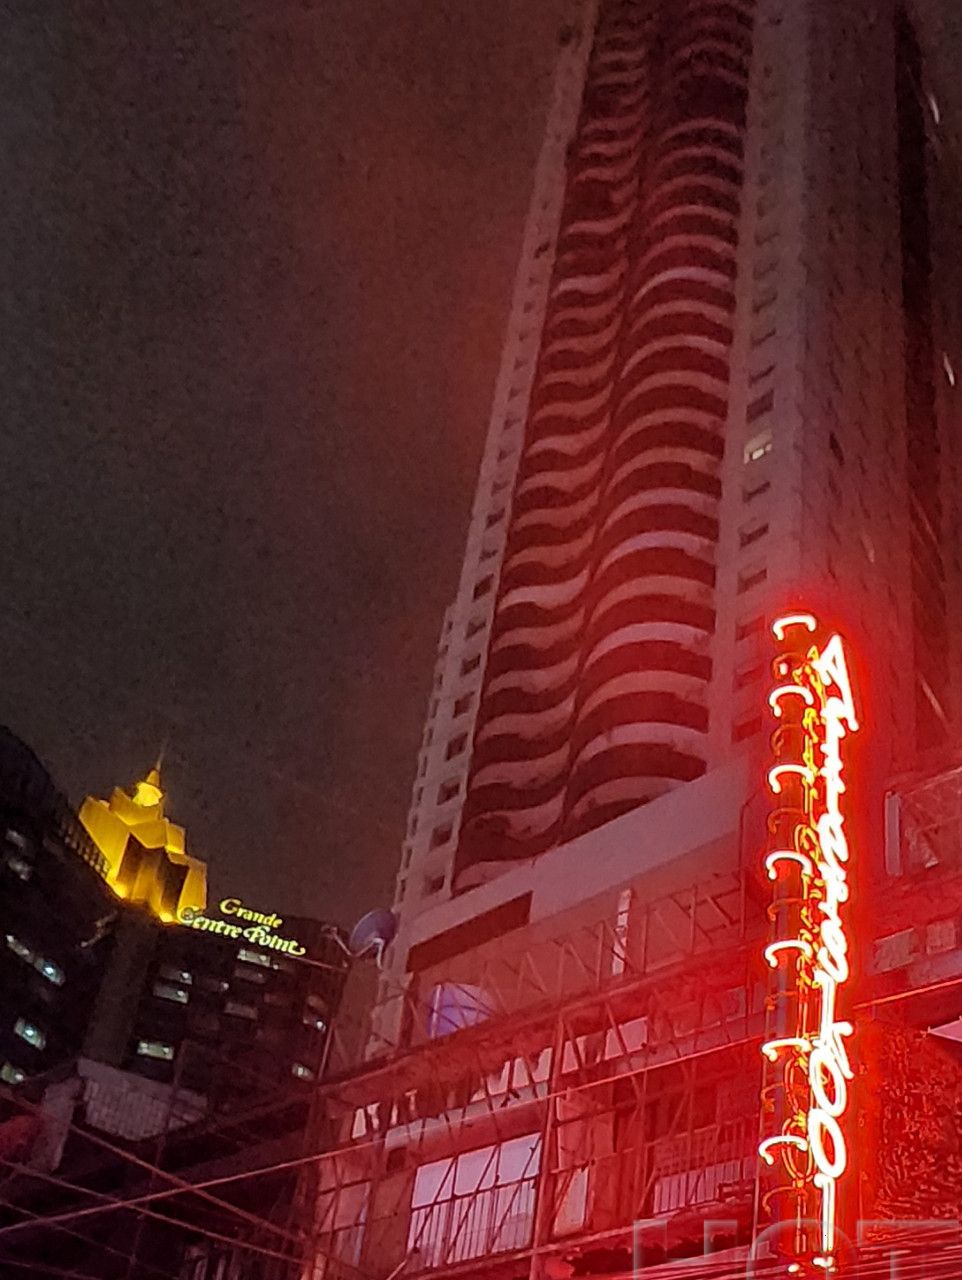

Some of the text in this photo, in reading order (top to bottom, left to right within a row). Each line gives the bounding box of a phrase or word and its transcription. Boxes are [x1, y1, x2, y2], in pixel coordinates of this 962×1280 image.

[176, 906, 306, 956] Centre Point
[220, 899, 283, 928] Grande
